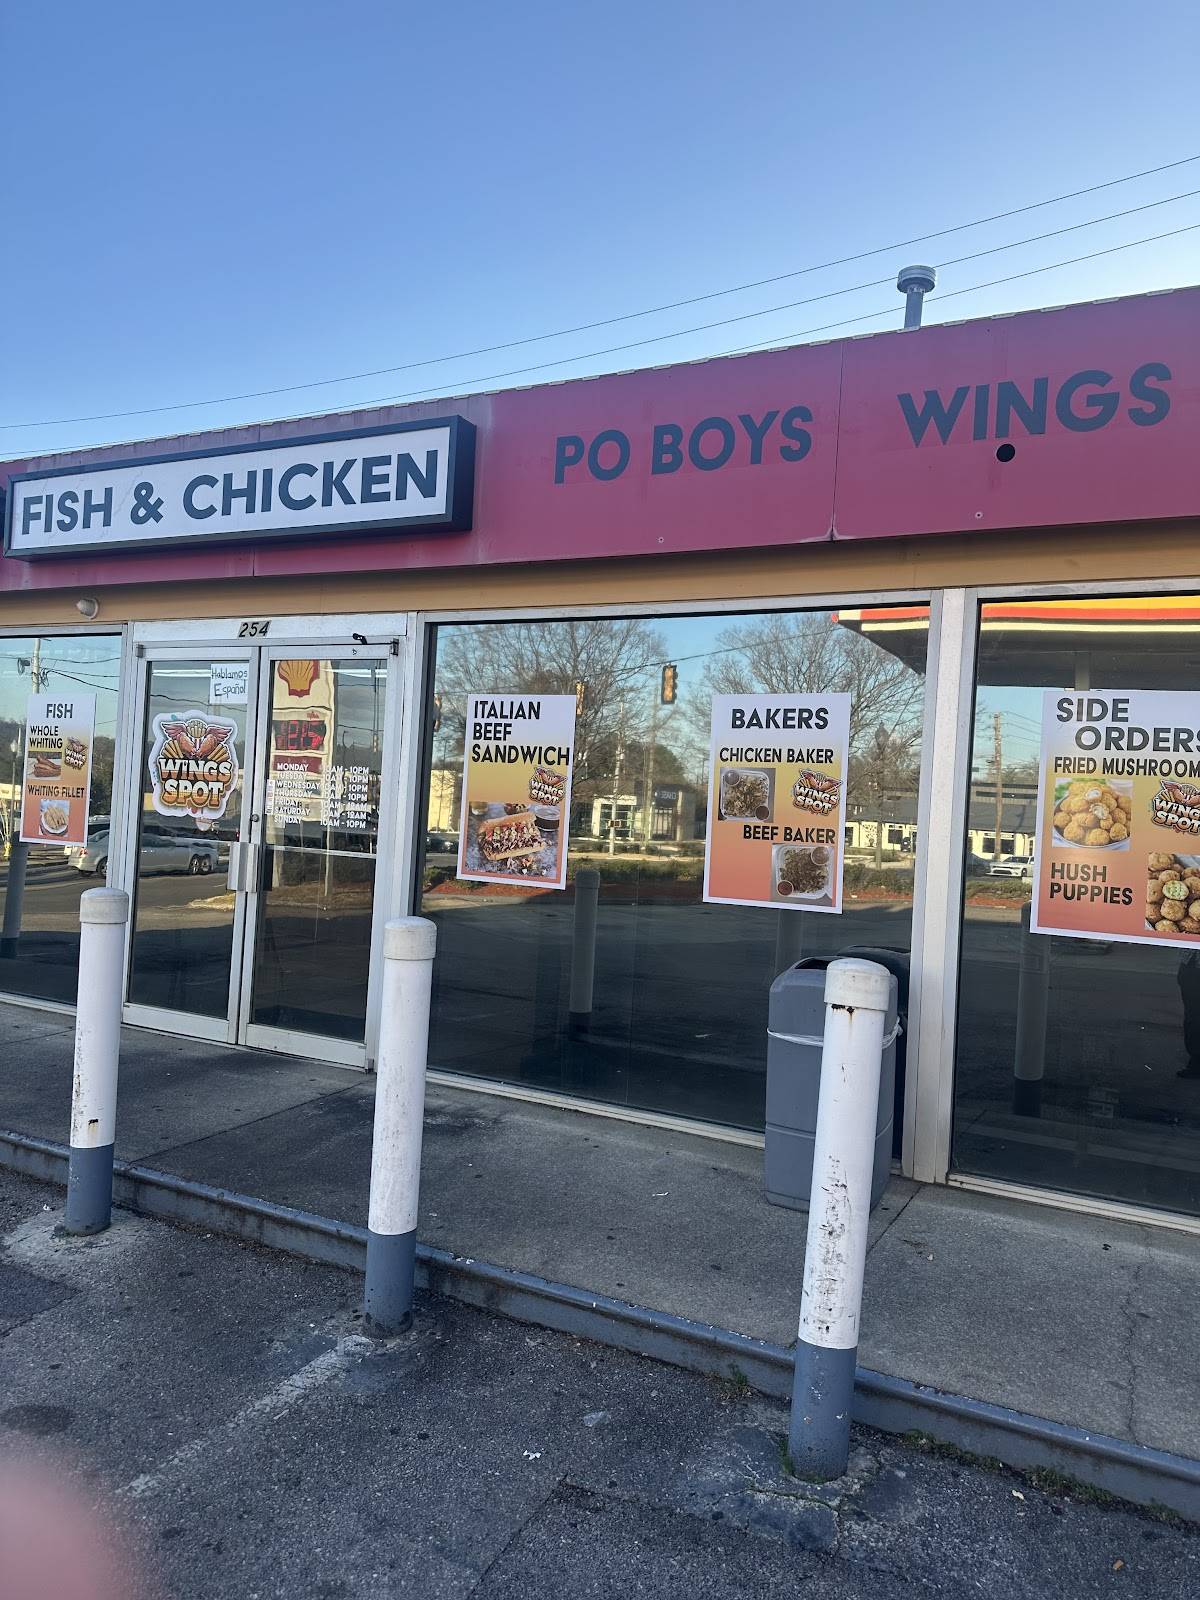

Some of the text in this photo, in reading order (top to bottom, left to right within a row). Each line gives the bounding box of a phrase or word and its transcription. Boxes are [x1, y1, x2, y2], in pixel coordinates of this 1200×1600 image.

[897, 362, 1173, 448] WINGS
[554, 405, 813, 484] PO BOYS
[22, 449, 438, 535] FISH & CHICKEN
[239, 621, 271, 638] 254
[211, 667, 248, 681] Hablamos
[213, 680, 247, 699] Español
[46, 703, 74, 719] FISH
[474, 700, 541, 720] ITALIAN
[731, 708, 829, 730] BAKERS
[1056, 697, 1130, 722] SIDE
[30, 725, 59, 736] WHOLE
[473, 722, 512, 741] BEEF
[29, 737, 63, 749] WHITING
[472, 743, 570, 766] SANDWICH
[719, 747, 834, 764] CHICKEN BAKER
[158, 757, 233, 783] WINGS
[277, 763, 309, 772] MONDAY
[349, 765, 370, 774] 10PM
[1054, 756, 1200, 778] FRIED MUSHROOM
[276, 780, 320, 789] WEDNESDAY
[348, 784, 368, 793] 10PM
[277, 772, 306, 780] TUESDAY
[349, 775, 369, 784] 10PM
[28, 784, 85, 799] WHITING FILLET
[161, 779, 225, 807] SPOT
[275, 789, 312, 798] THURSDAY
[348, 792, 368, 802] 10PM
[531, 789, 559, 806] SPOT
[795, 784, 838, 805] WINGS
[274, 797, 299, 807] FRIDAY
[795, 795, 832, 815] SPOT
[274, 806, 310, 816] SATURDAY
[347, 811, 367, 820] 12AM
[274, 814, 301, 824] SUNDAY
[320, 818, 340, 827] 10AM
[346, 819, 366, 829] 10PM
[1153, 810, 1200, 833] SPOT
[743, 824, 836, 844] BEEF BAKER
[1051, 862, 1107, 882] HUSH
[1049, 882, 1133, 905] PUPPIES
